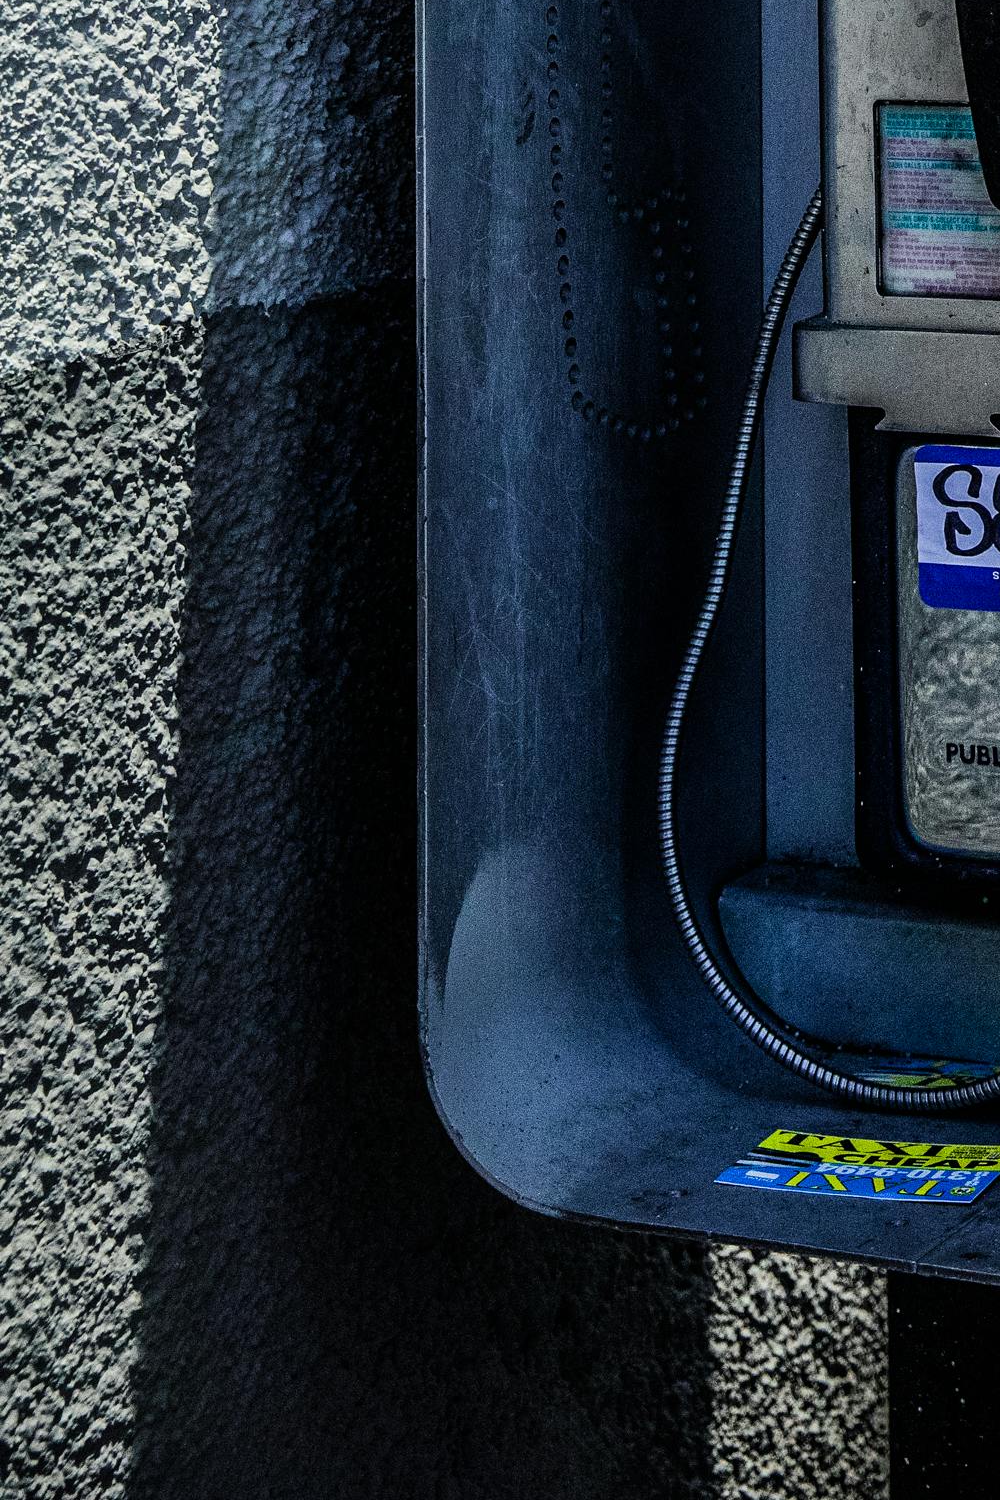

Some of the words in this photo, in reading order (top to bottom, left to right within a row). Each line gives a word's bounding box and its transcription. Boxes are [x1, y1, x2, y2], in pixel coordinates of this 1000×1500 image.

[779, 1129, 951, 1157] TAXI
[834, 1153, 999, 1170] CHEAP
[780, 1170, 946, 1198] TAXI
